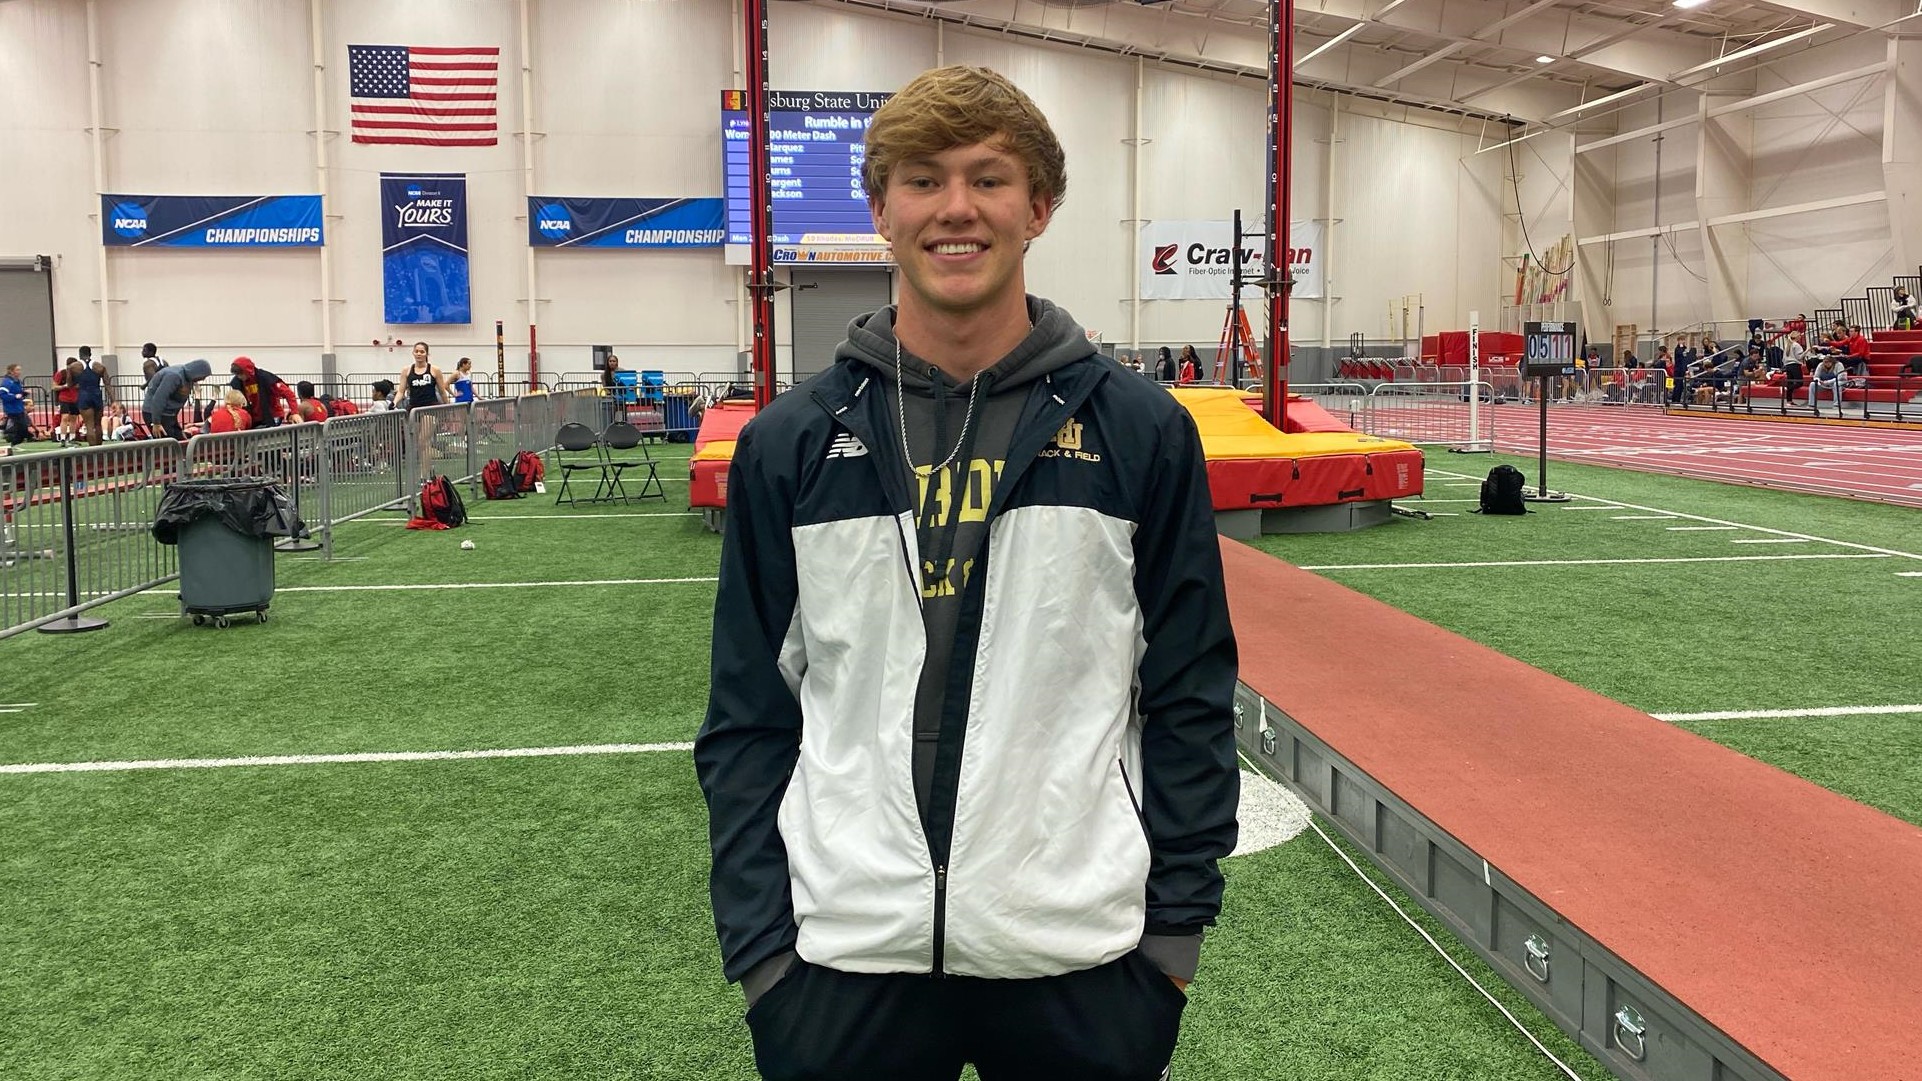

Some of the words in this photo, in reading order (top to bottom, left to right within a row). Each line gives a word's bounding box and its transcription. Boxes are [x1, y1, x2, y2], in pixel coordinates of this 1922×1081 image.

[814, 92, 851, 108] State
[804, 116, 849, 129] Rumble
[850, 116, 863, 129] in
[783, 130, 812, 140] Meter
[812, 130, 837, 140] Dash
[770, 143, 804, 154] arquez
[770, 156, 794, 164] ames
[771, 167, 791, 175] urns
[771, 178, 802, 188] argent
[771, 189, 803, 198] ackson
[416, 199, 442, 208] MAKE
[443, 199, 453, 207] IT
[394, 201, 452, 228] YOURS
[114, 218, 147, 230] NCAA
[539, 219, 571, 231] NCAA
[206, 227, 320, 244] CHAMPIONSHIPS
[625, 229, 725, 244] CHAMPIONSHIP
[1186, 242, 1313, 265] Craw-an
[1189, 267, 1226, 276] Fiber-Optic
[1038, 449, 1060, 458] ACK
[1064, 450, 1072, 458] &
[1074, 451, 1101, 462] FIELD
